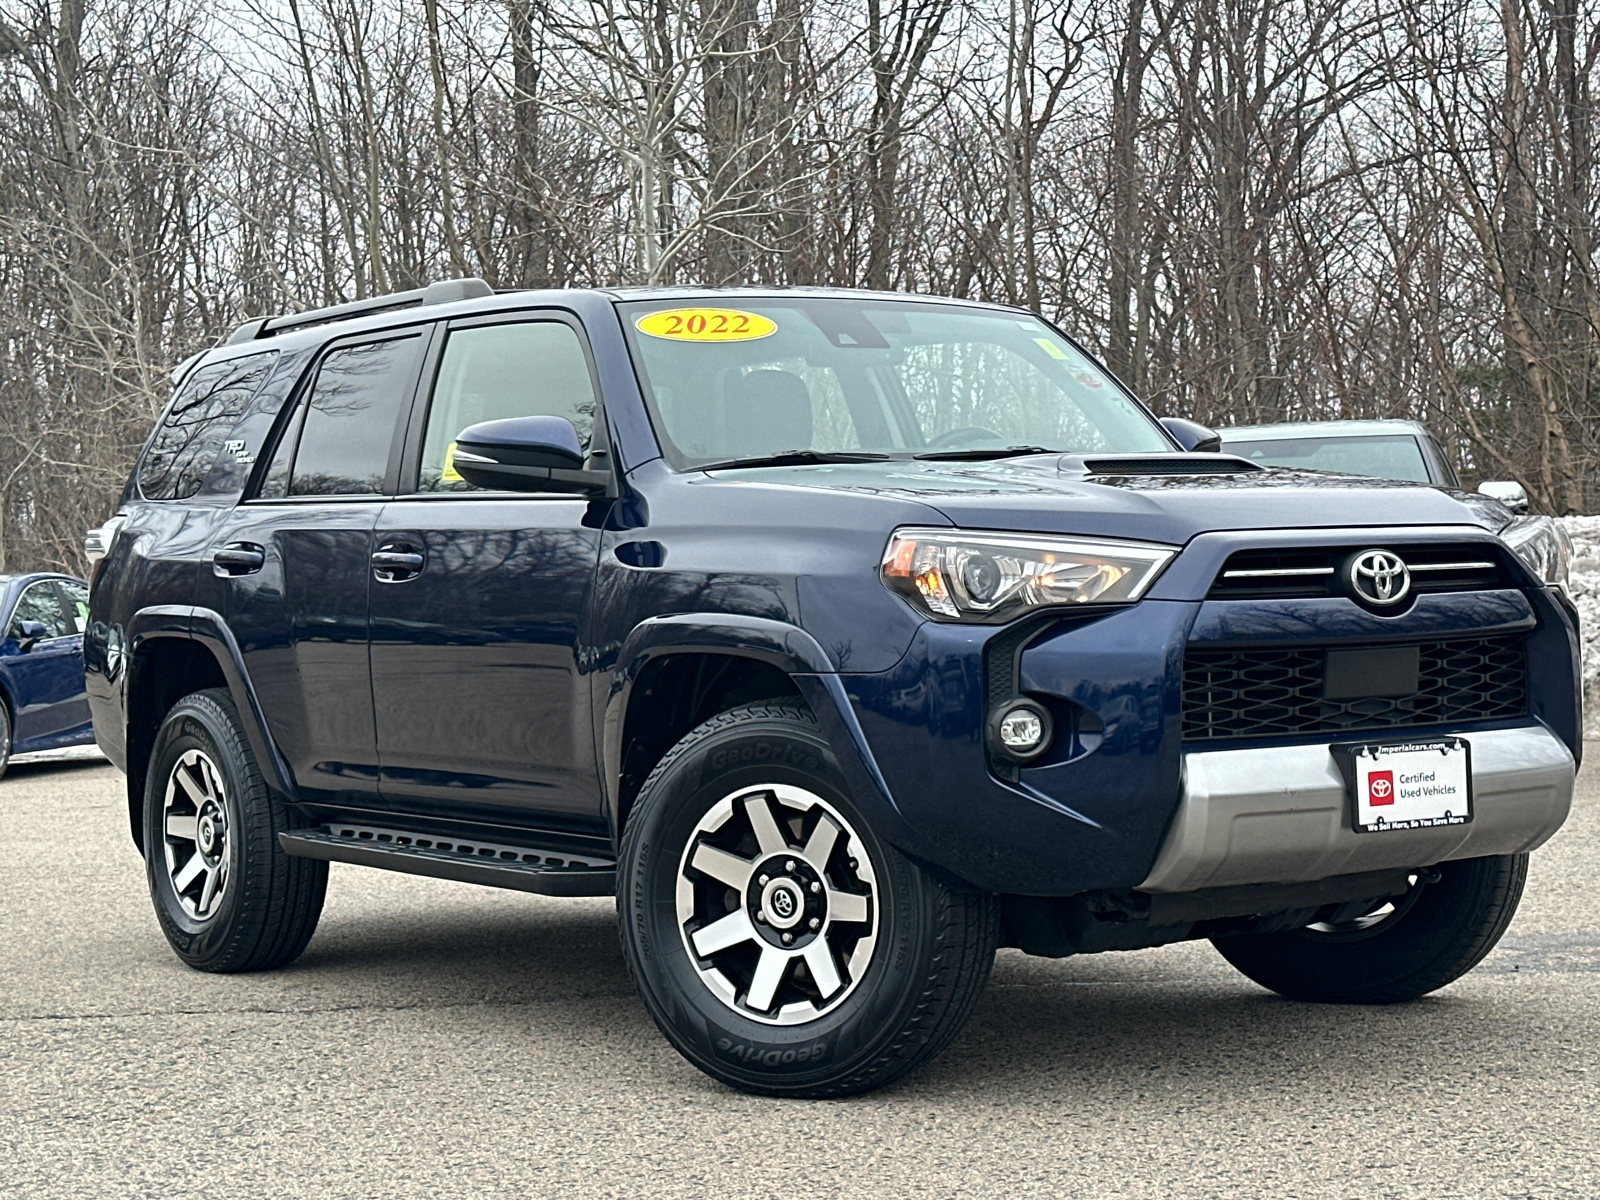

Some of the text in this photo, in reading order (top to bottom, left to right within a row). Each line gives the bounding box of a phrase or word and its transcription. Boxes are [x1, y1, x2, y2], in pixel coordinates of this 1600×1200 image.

[665, 315, 750, 335] 2022
[224, 440, 245, 454] TRD
[712, 743, 820, 770] GeoDrive
[1400, 771, 1436, 784] Certified
[1400, 785, 1456, 798] Used Vehicles
[1367, 824, 1379, 832] We
[1379, 822, 1391, 831] Sell
[1392, 821, 1410, 830] More,
[1410, 820, 1419, 828] So
[1420, 819, 1432, 827] You
[1448, 816, 1465, 824] More
[636, 842, 651, 876] 115S
[635, 881, 644, 909] R17
[717, 1037, 828, 1067] GeoDrive
